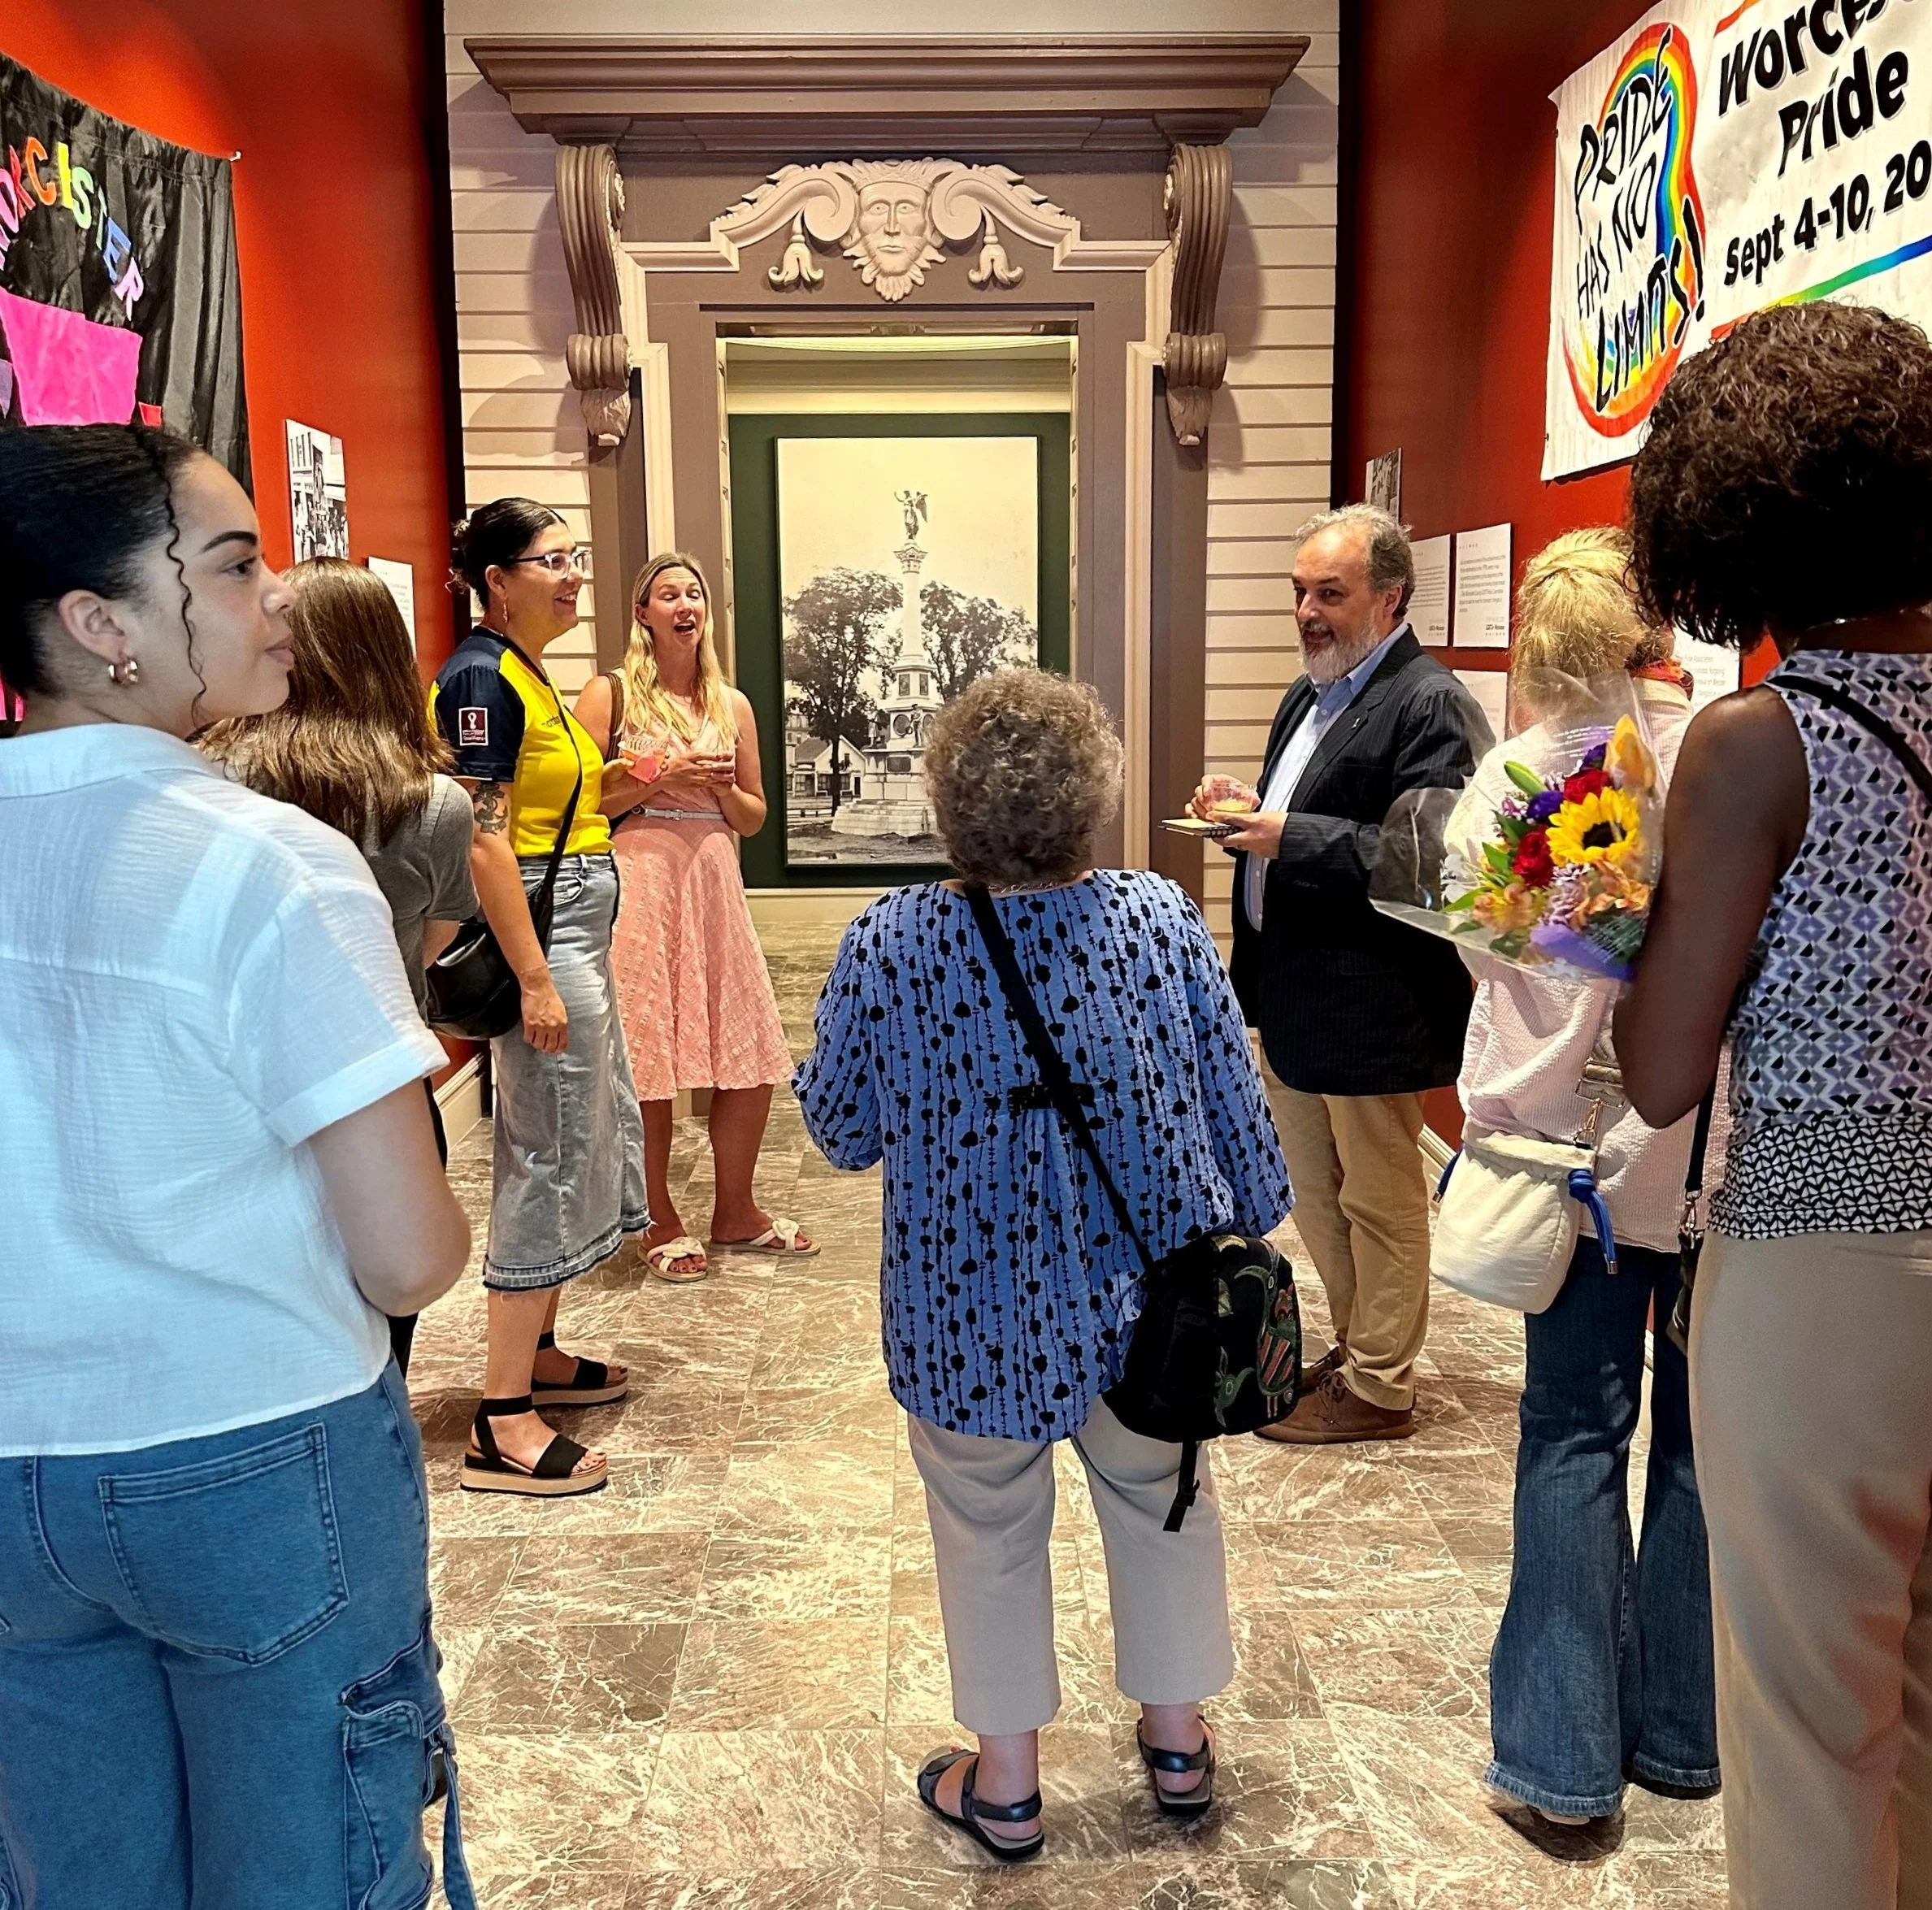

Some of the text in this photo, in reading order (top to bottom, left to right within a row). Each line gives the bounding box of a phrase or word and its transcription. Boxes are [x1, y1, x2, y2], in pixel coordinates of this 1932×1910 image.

[1574, 27, 1671, 237] PRIDE
[1778, 46, 1908, 178] Pride
[1577, 152, 1656, 321] HAS NO
[1794, 173, 1874, 250] 4-10,
